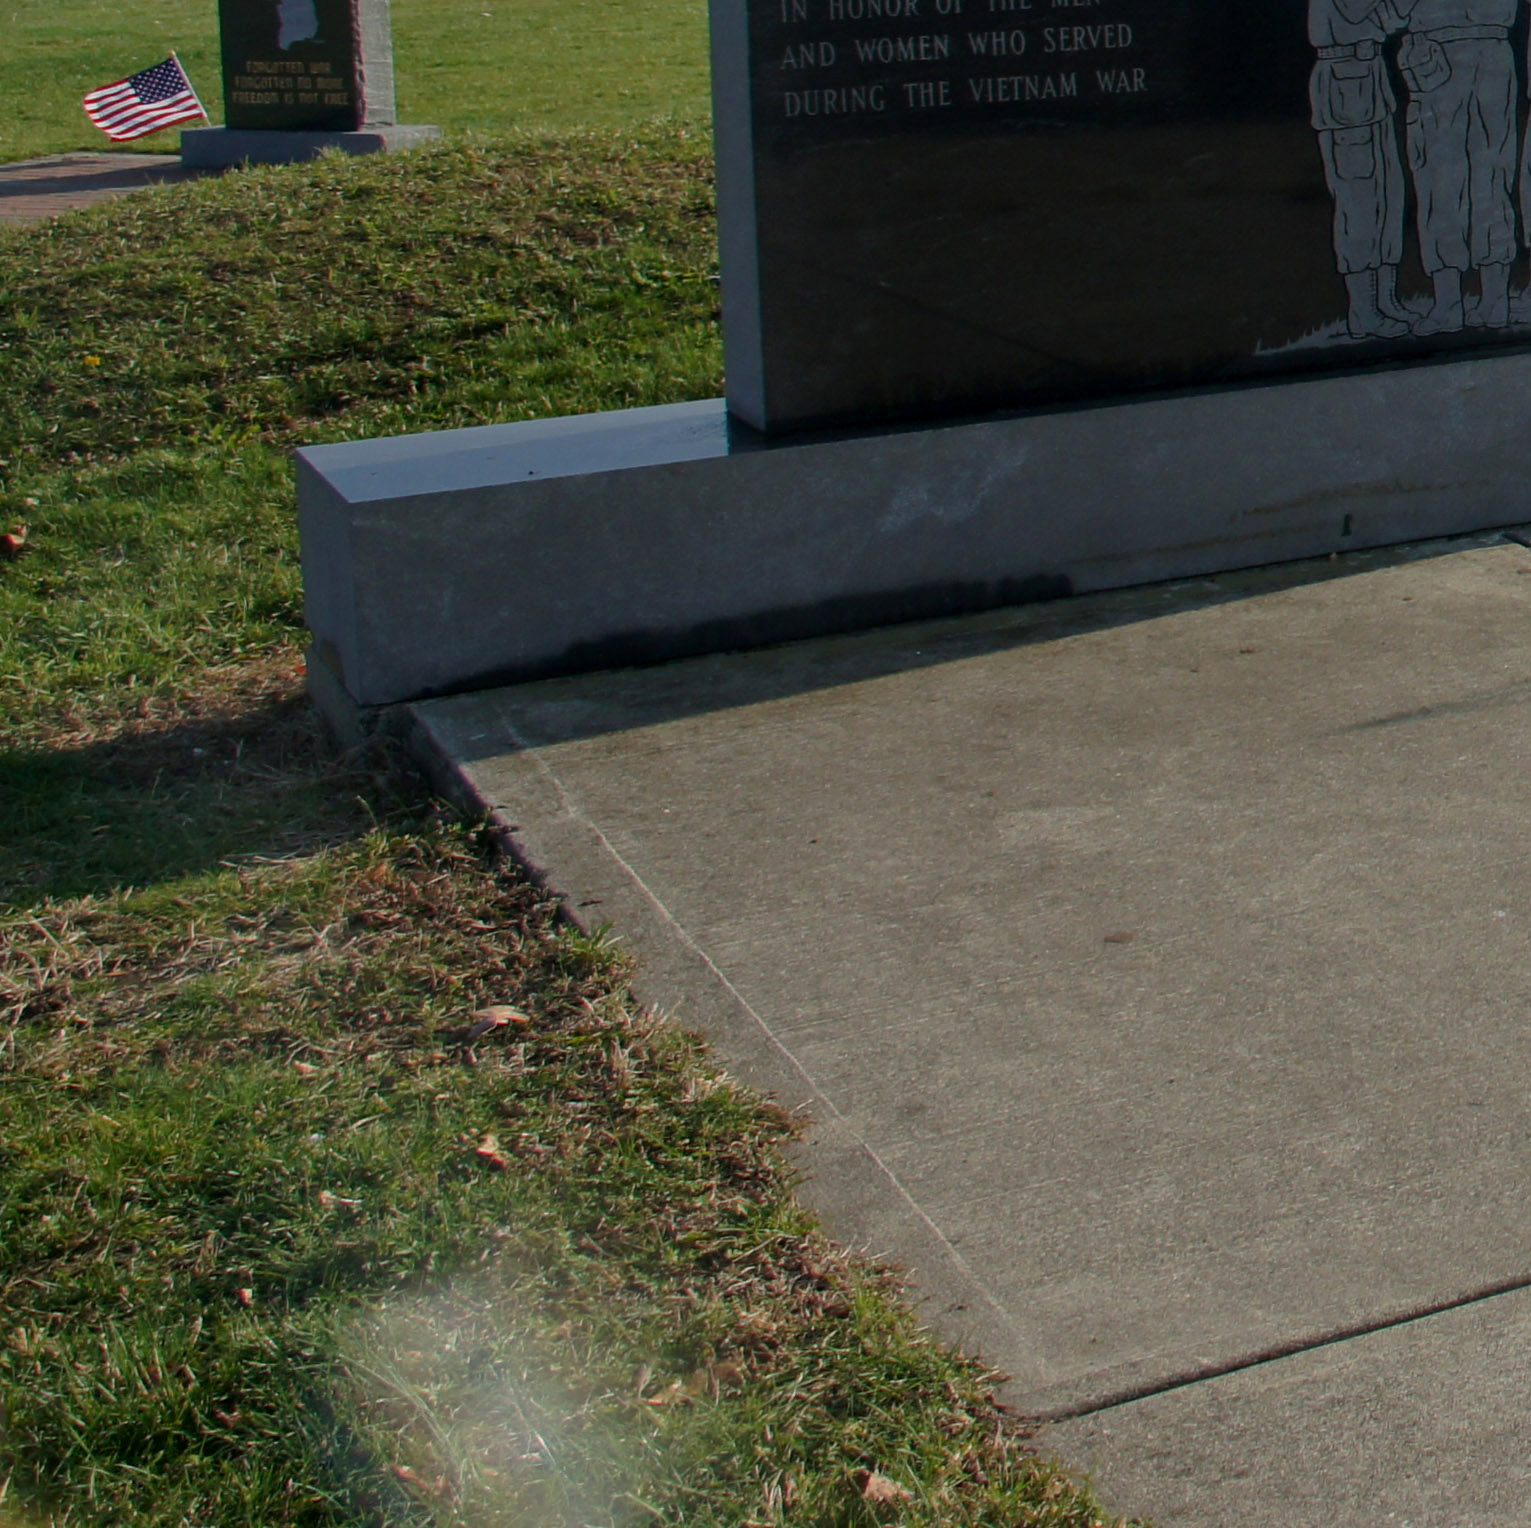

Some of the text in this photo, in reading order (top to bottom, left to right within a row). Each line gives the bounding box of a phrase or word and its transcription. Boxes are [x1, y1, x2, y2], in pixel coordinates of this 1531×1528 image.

[780, 23, 1132, 69] AND WOMEN WHO SERVED
[784, 68, 1147, 117] DURING THE VIETNAM WAR
